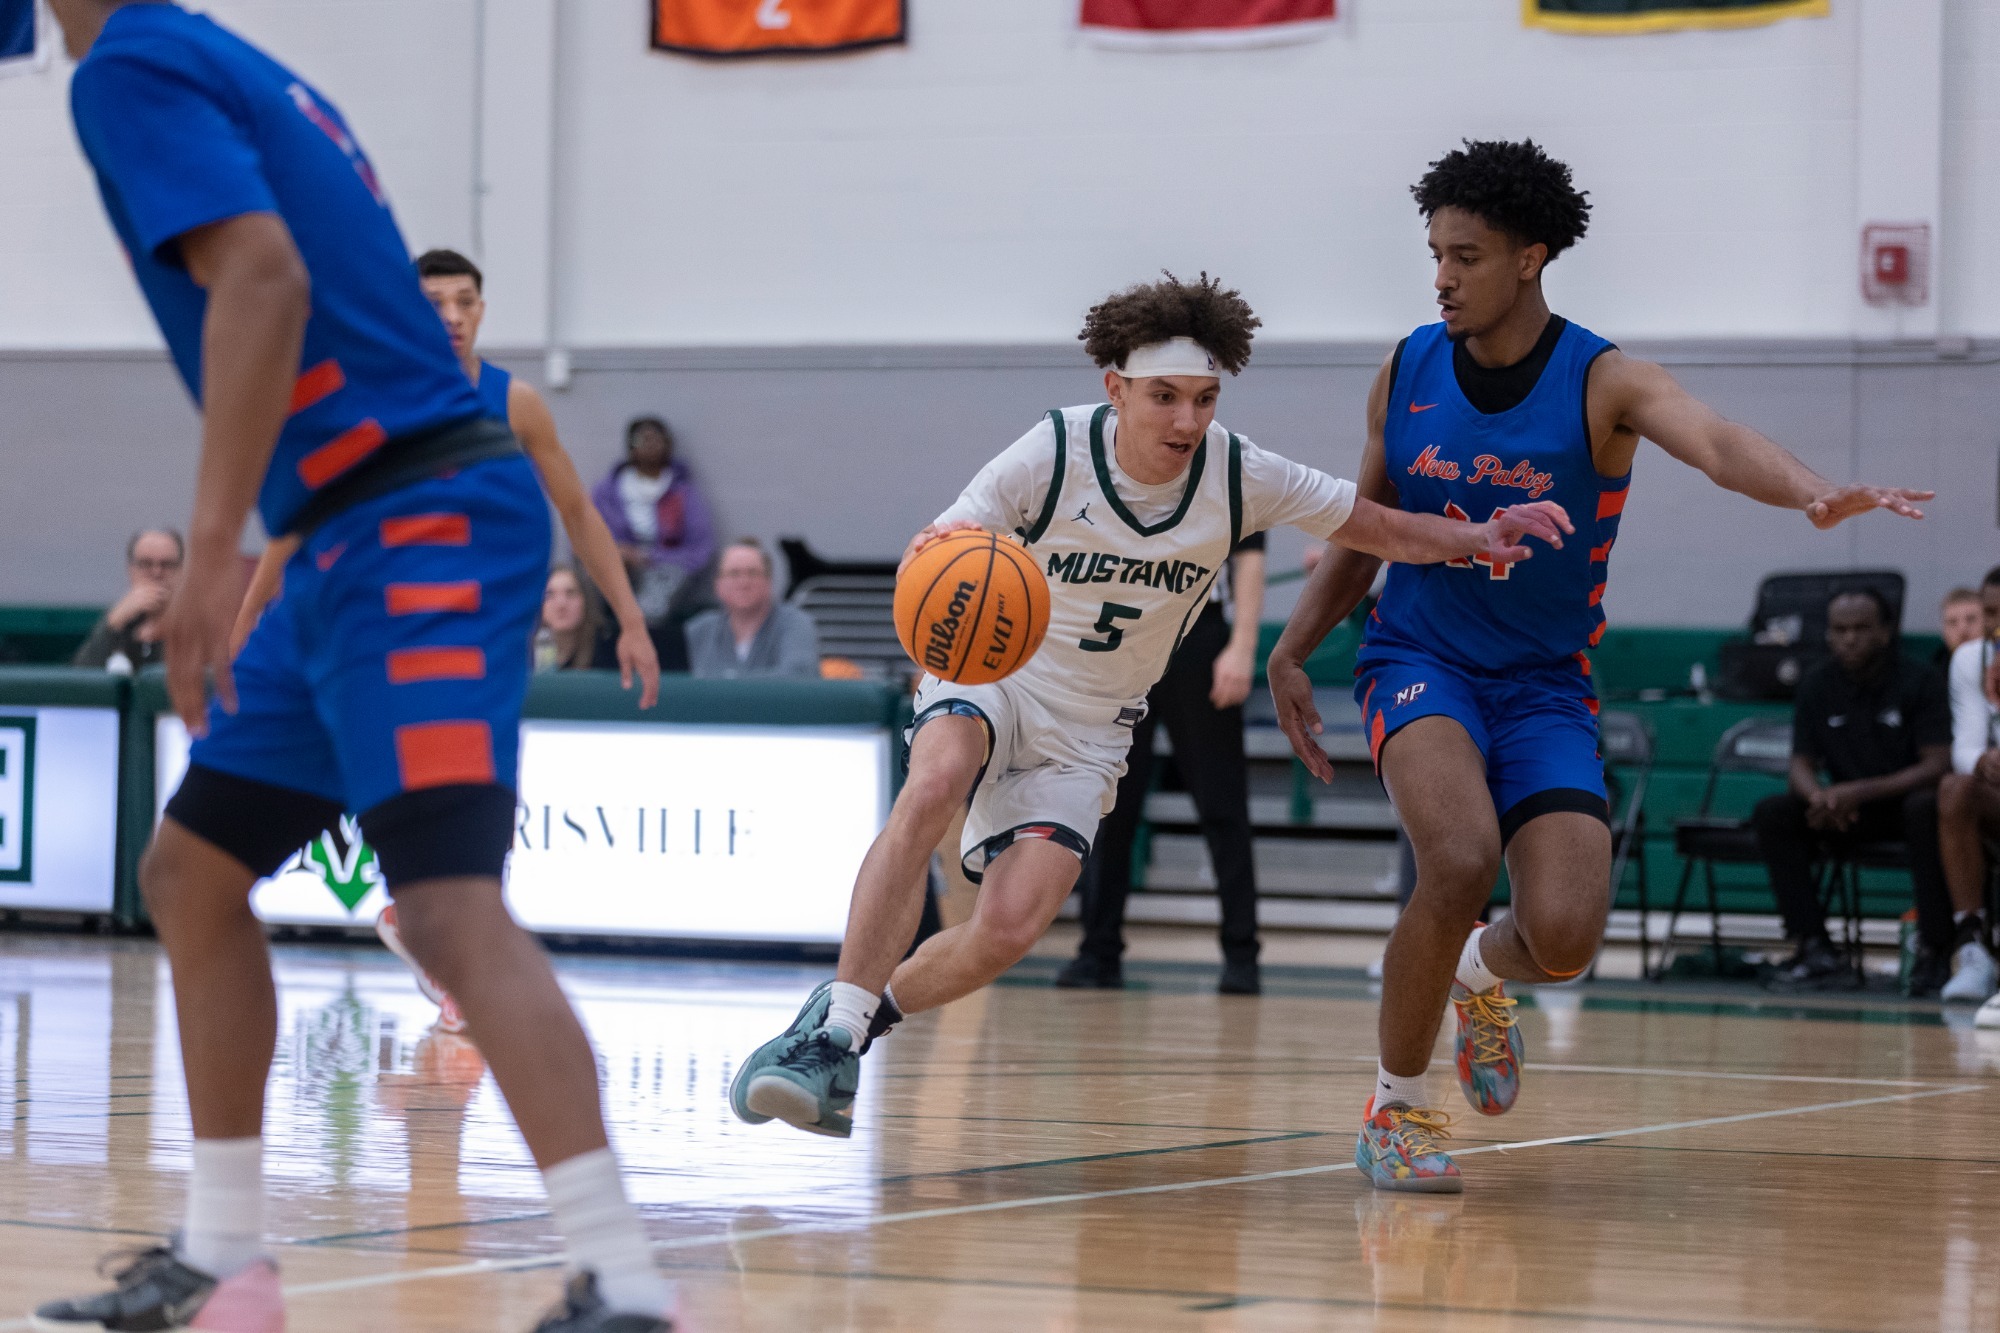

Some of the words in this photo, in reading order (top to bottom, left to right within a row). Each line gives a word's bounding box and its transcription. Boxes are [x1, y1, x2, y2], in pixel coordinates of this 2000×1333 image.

[1407, 444, 1461, 480] New
[1466, 454, 1554, 498] Paltz
[924, 580, 977, 671] Wilson
[1078, 601, 1143, 652] 5
[1393, 682, 1427, 708] NP
